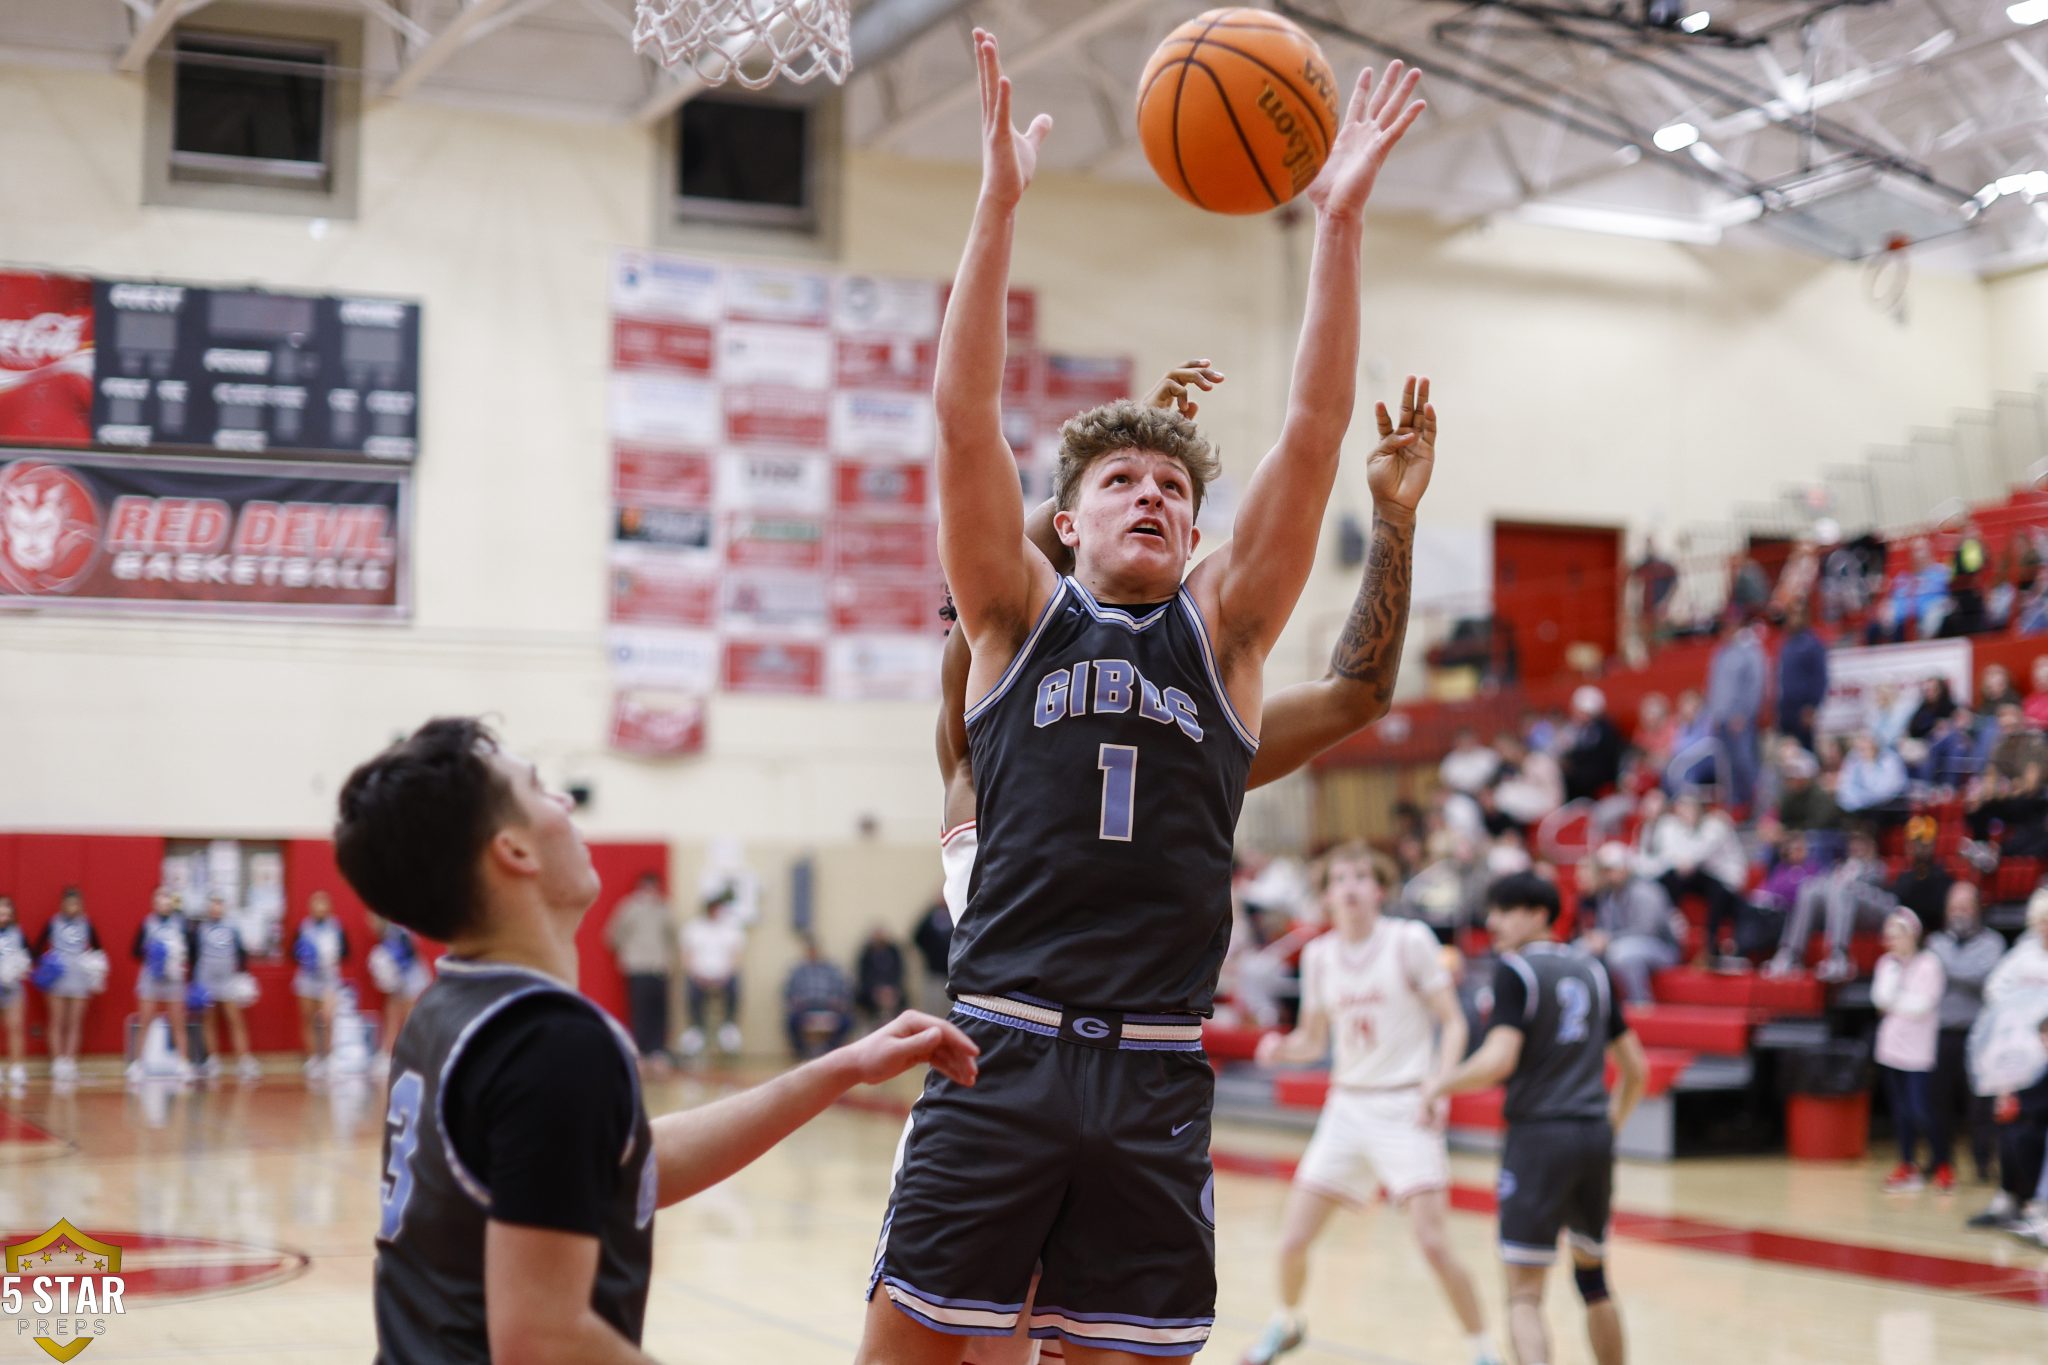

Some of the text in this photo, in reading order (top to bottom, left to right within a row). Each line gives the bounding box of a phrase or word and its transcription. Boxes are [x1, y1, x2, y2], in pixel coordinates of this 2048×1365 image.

[105, 495, 396, 563] RED DEVIL
[111, 553, 391, 590] BASKETBALL
[1033, 658, 1204, 743] GIBBS
[1097, 743, 1138, 842] 1
[1072, 1016, 1110, 1039] G
